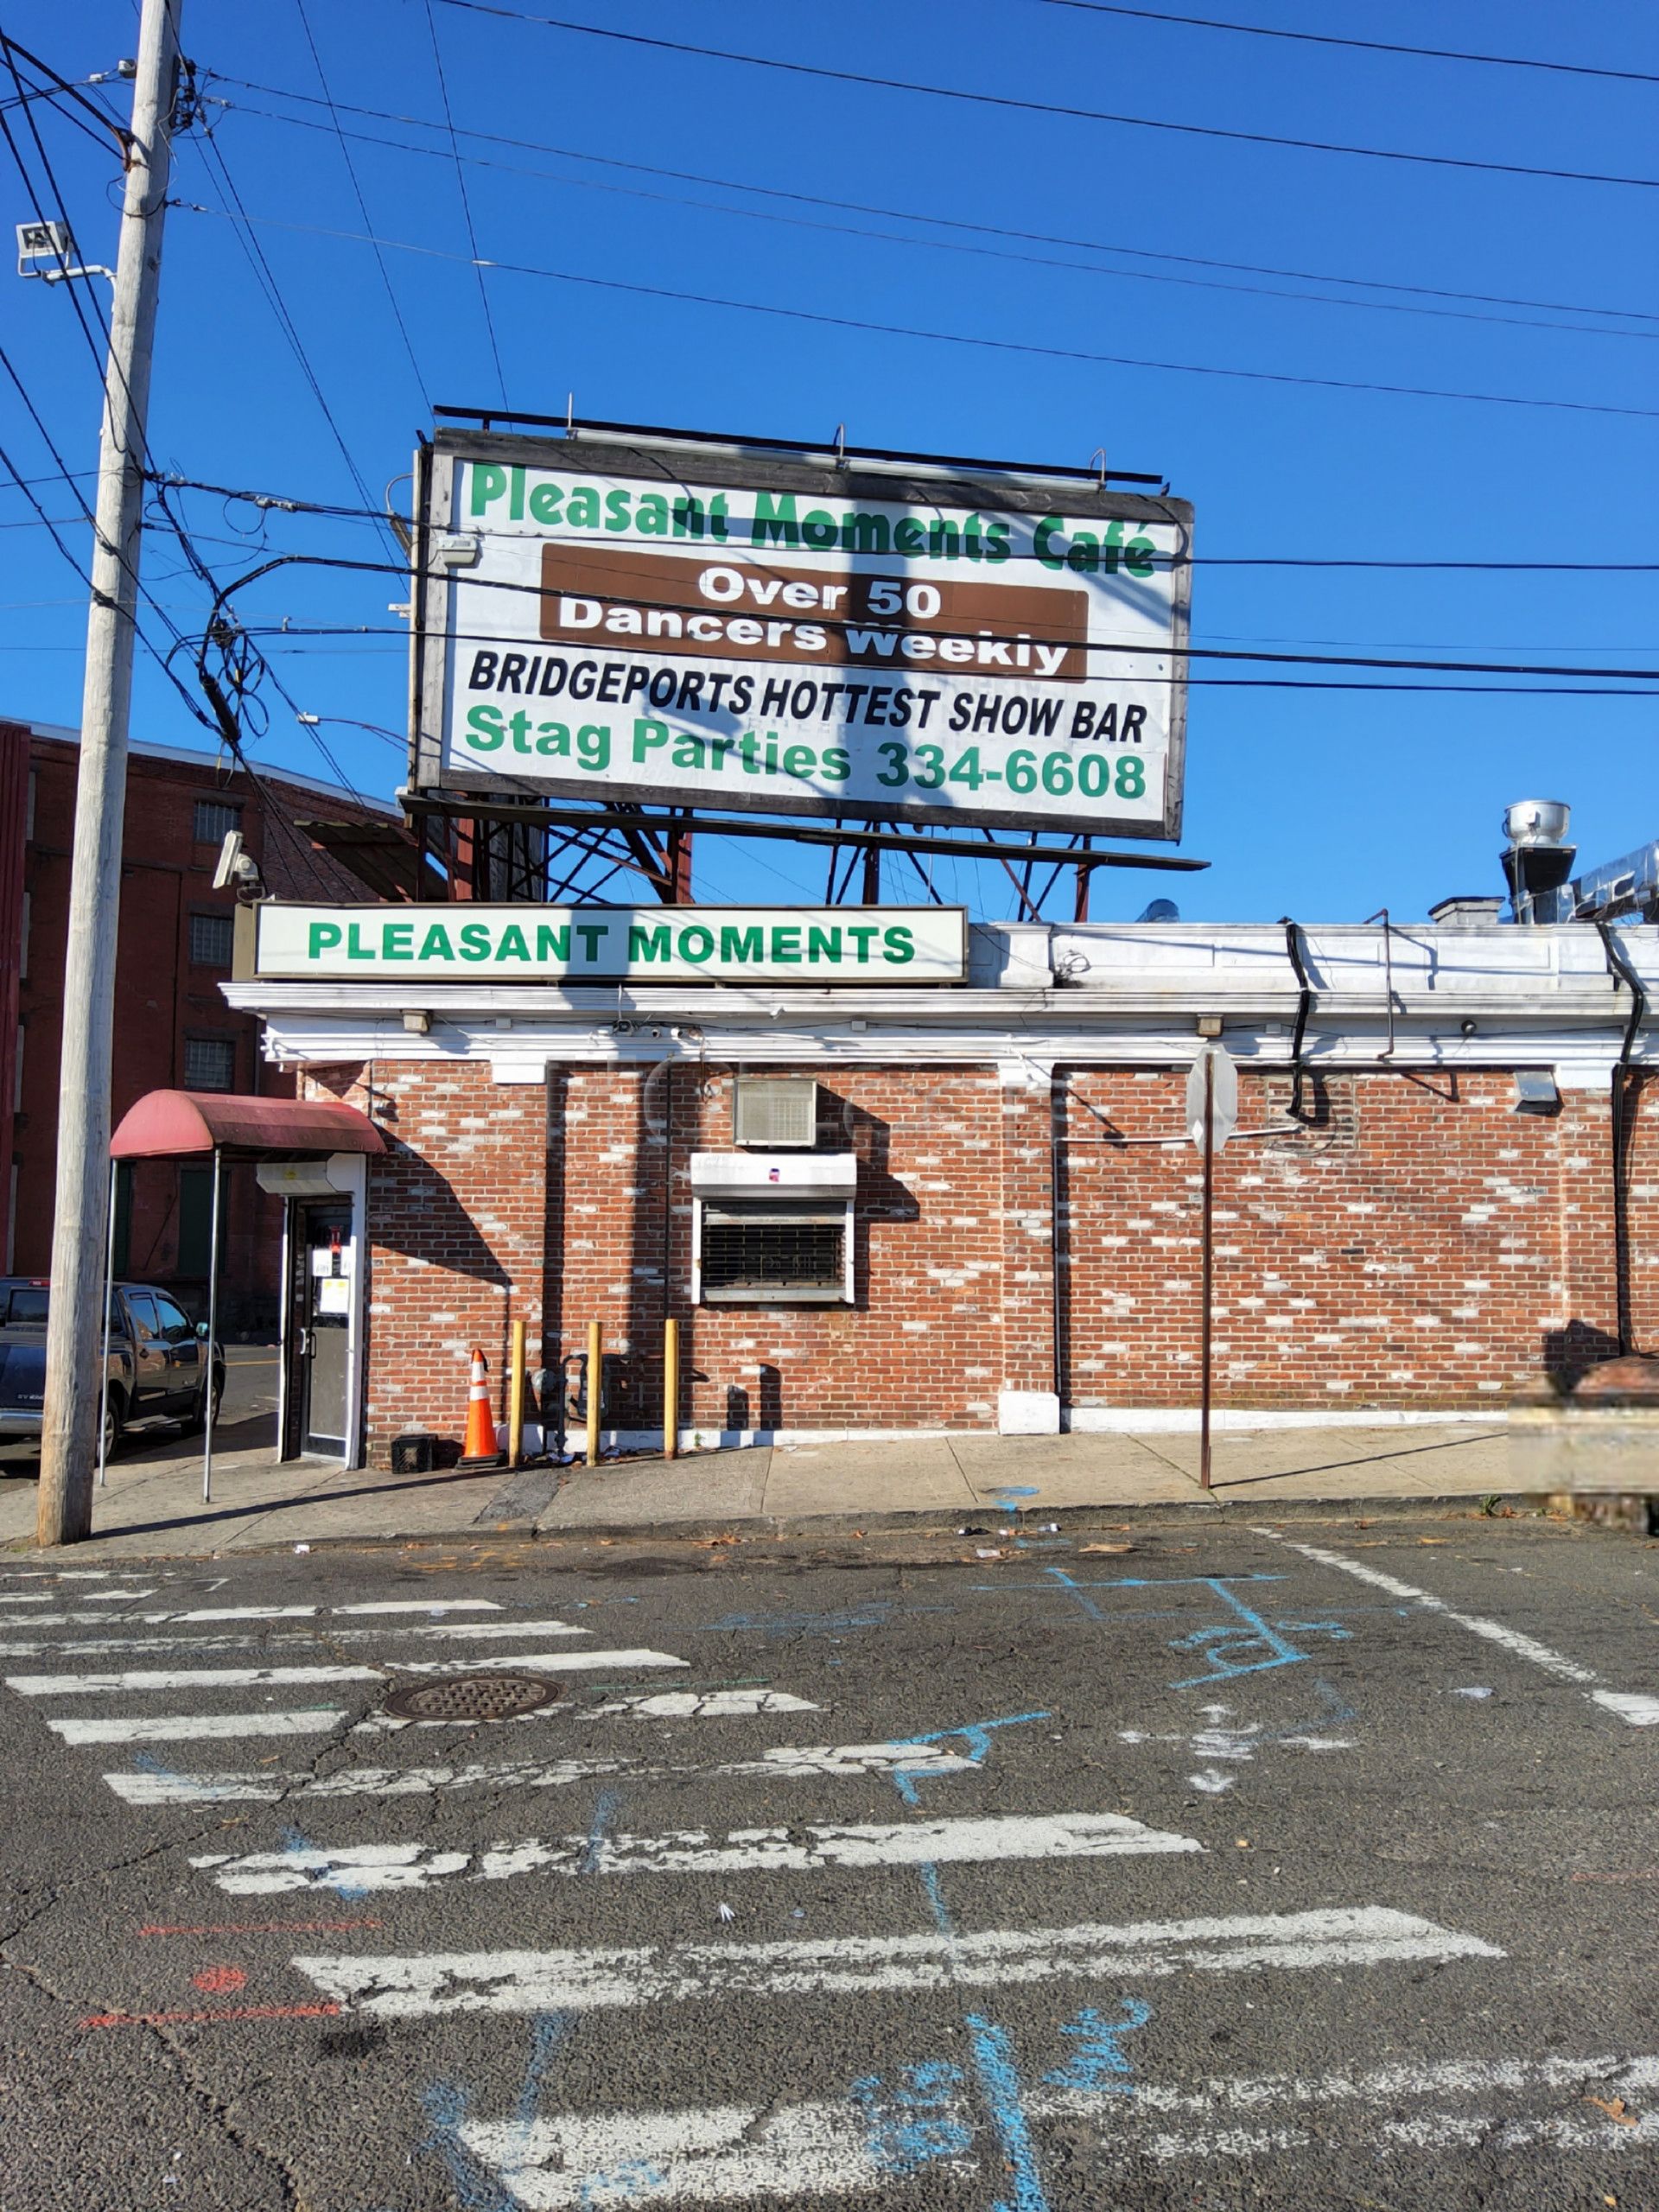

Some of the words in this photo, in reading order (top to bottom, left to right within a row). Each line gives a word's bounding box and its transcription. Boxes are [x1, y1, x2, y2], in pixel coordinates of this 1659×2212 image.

[471, 461, 728, 540] Pleasant
[751, 492, 1011, 564] Moments
[1033, 515, 1156, 577] Café
[559, 596, 827, 651] Dancers
[698, 567, 849, 610] Over
[866, 581, 941, 619] 50
[468, 650, 754, 715] BRIDGEPORTS
[760, 677, 941, 729] HOTTEST
[949, 691, 1065, 737] SHOW
[1070, 701, 1148, 743] BAR
[466, 705, 611, 771] Stag
[632, 719, 851, 780] Parties
[876, 742, 1147, 799] 334-6608
[308, 922, 609, 963] PLEASANT
[628, 925, 917, 964] MOMENTS
